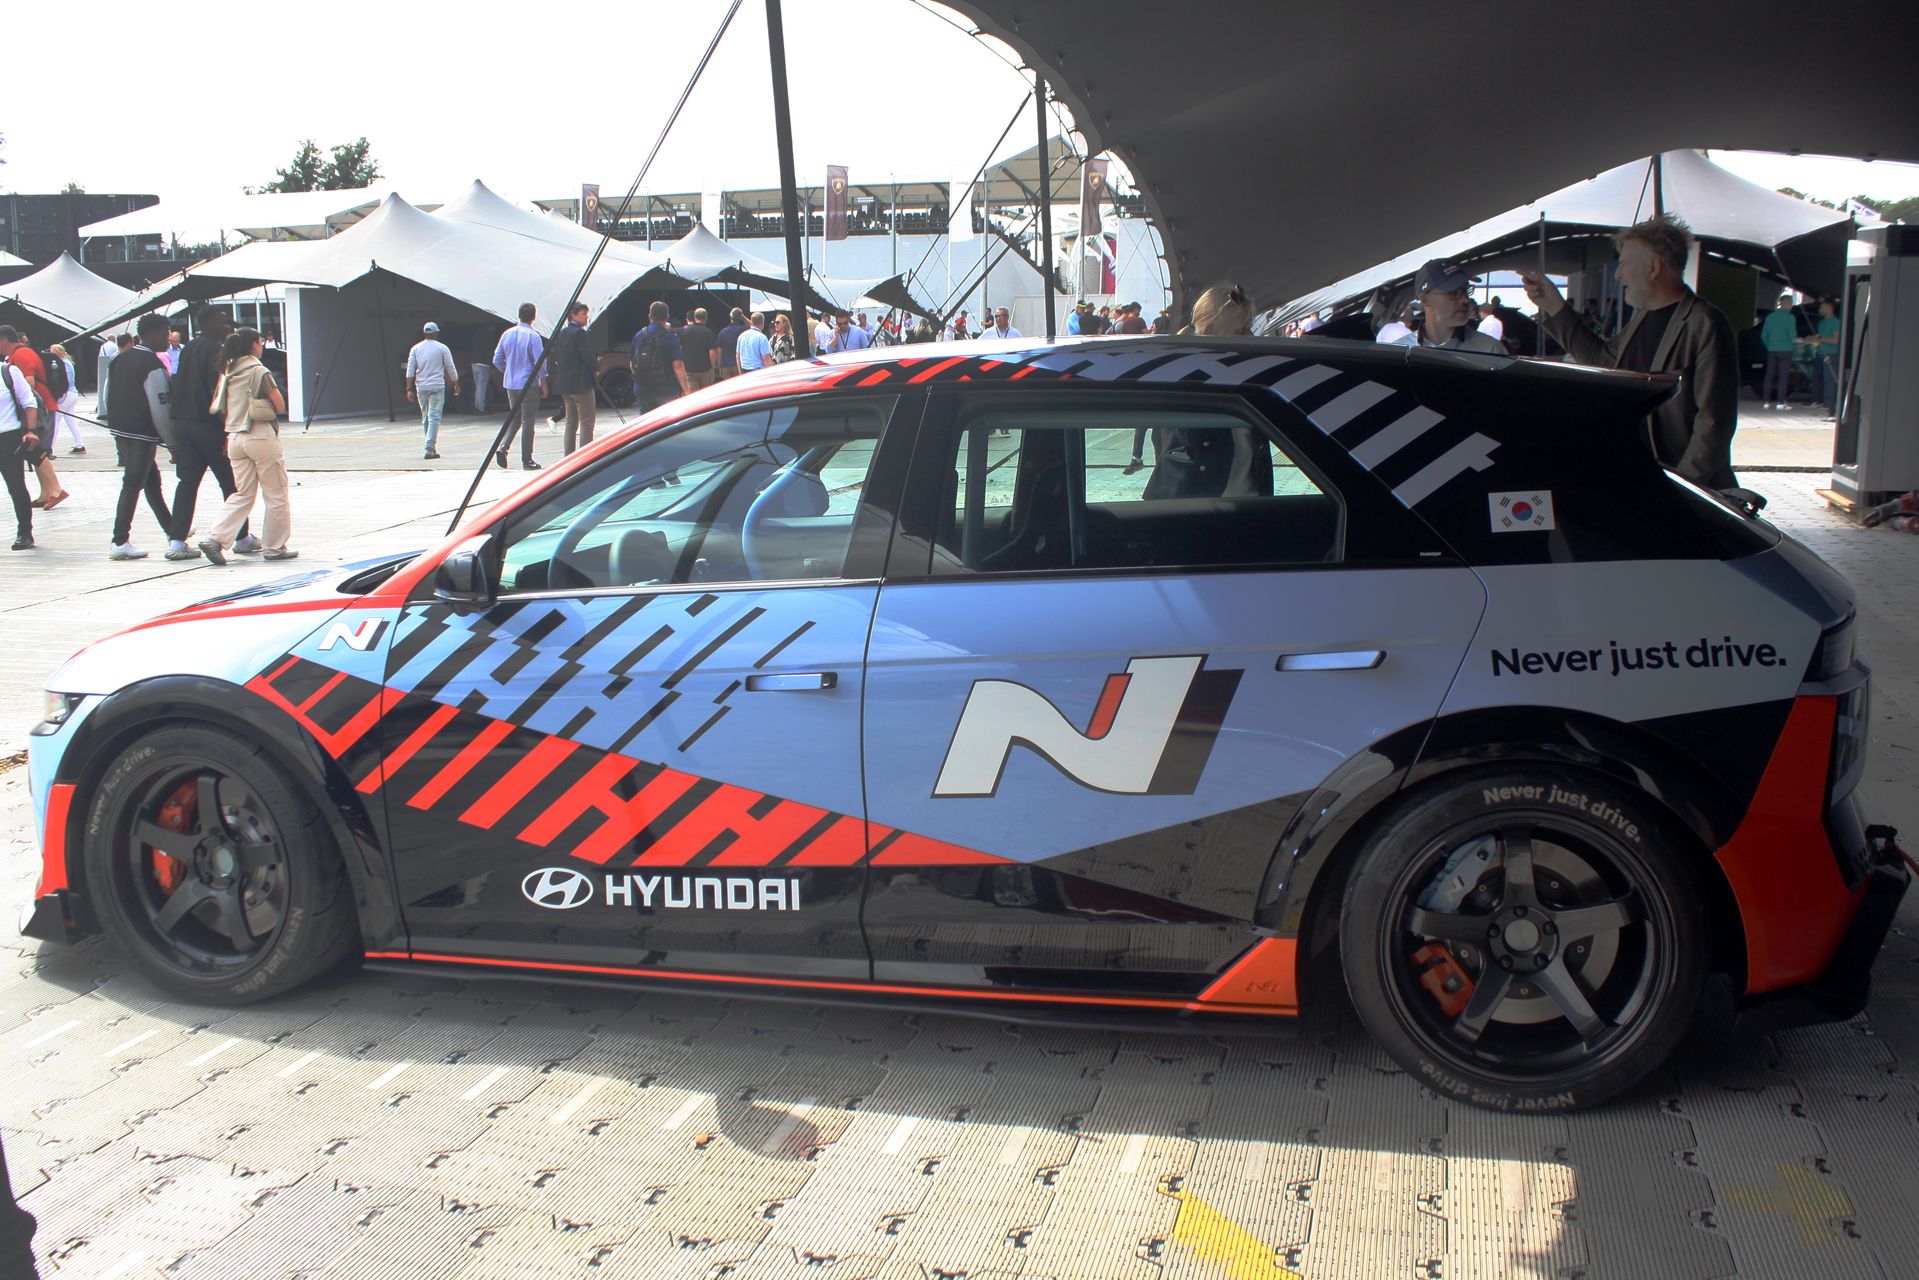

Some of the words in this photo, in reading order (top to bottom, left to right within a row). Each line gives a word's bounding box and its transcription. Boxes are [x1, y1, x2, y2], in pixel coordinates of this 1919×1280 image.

[1490, 648, 1602, 676] Never
[1609, 640, 1680, 677] just
[1685, 636, 1787, 669] drive.
[89, 793, 105, 836] Never
[103, 768, 125, 796] just
[1482, 785, 1545, 805] Never
[1548, 784, 1589, 811] just
[1590, 801, 1641, 843] drive.
[605, 874, 800, 911] HYUNDAI
[281, 906, 304, 949] Never
[263, 948, 289, 974] just
[1419, 1059, 1468, 1096] drive.
[1515, 1091, 1576, 1109] Never
